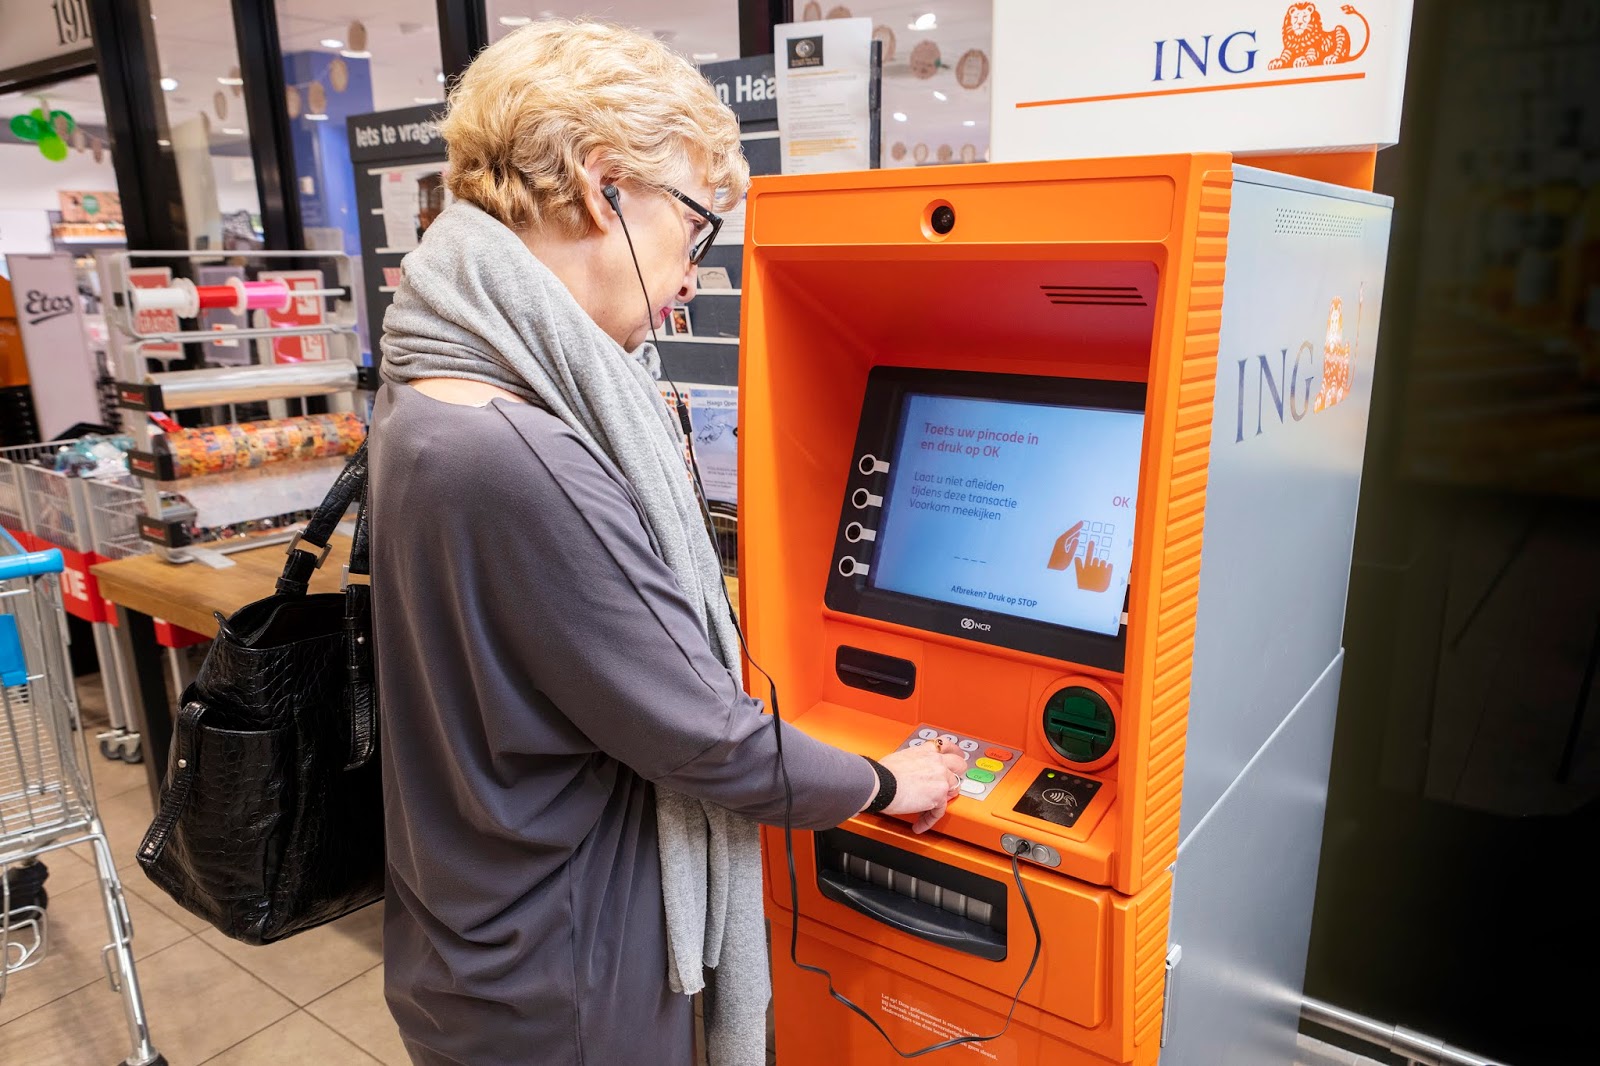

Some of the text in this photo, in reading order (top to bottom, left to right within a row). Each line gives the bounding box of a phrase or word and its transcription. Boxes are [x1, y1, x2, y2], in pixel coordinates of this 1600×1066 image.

[1151, 30, 1259, 82] ING
[355, 121, 440, 148] Iets te vrage
[25, 290, 73, 321] Etos
[1235, 340, 1314, 443] ING
[924, 422, 1039, 445] Toets uw pincode in
[920, 441, 1001, 458] en druk op OK
[914, 471, 1005, 492] Laat u niet afleiden
[911, 485, 1018, 509] tijdens deze transactie
[1112, 495, 1131, 509] OK
[909, 498, 1001, 521] Voorkom meekijken
[951, 585, 1038, 608] Afbreken? Druk op STOP
[974, 622, 991, 632] NCR
[963, 741, 973, 749] 3
